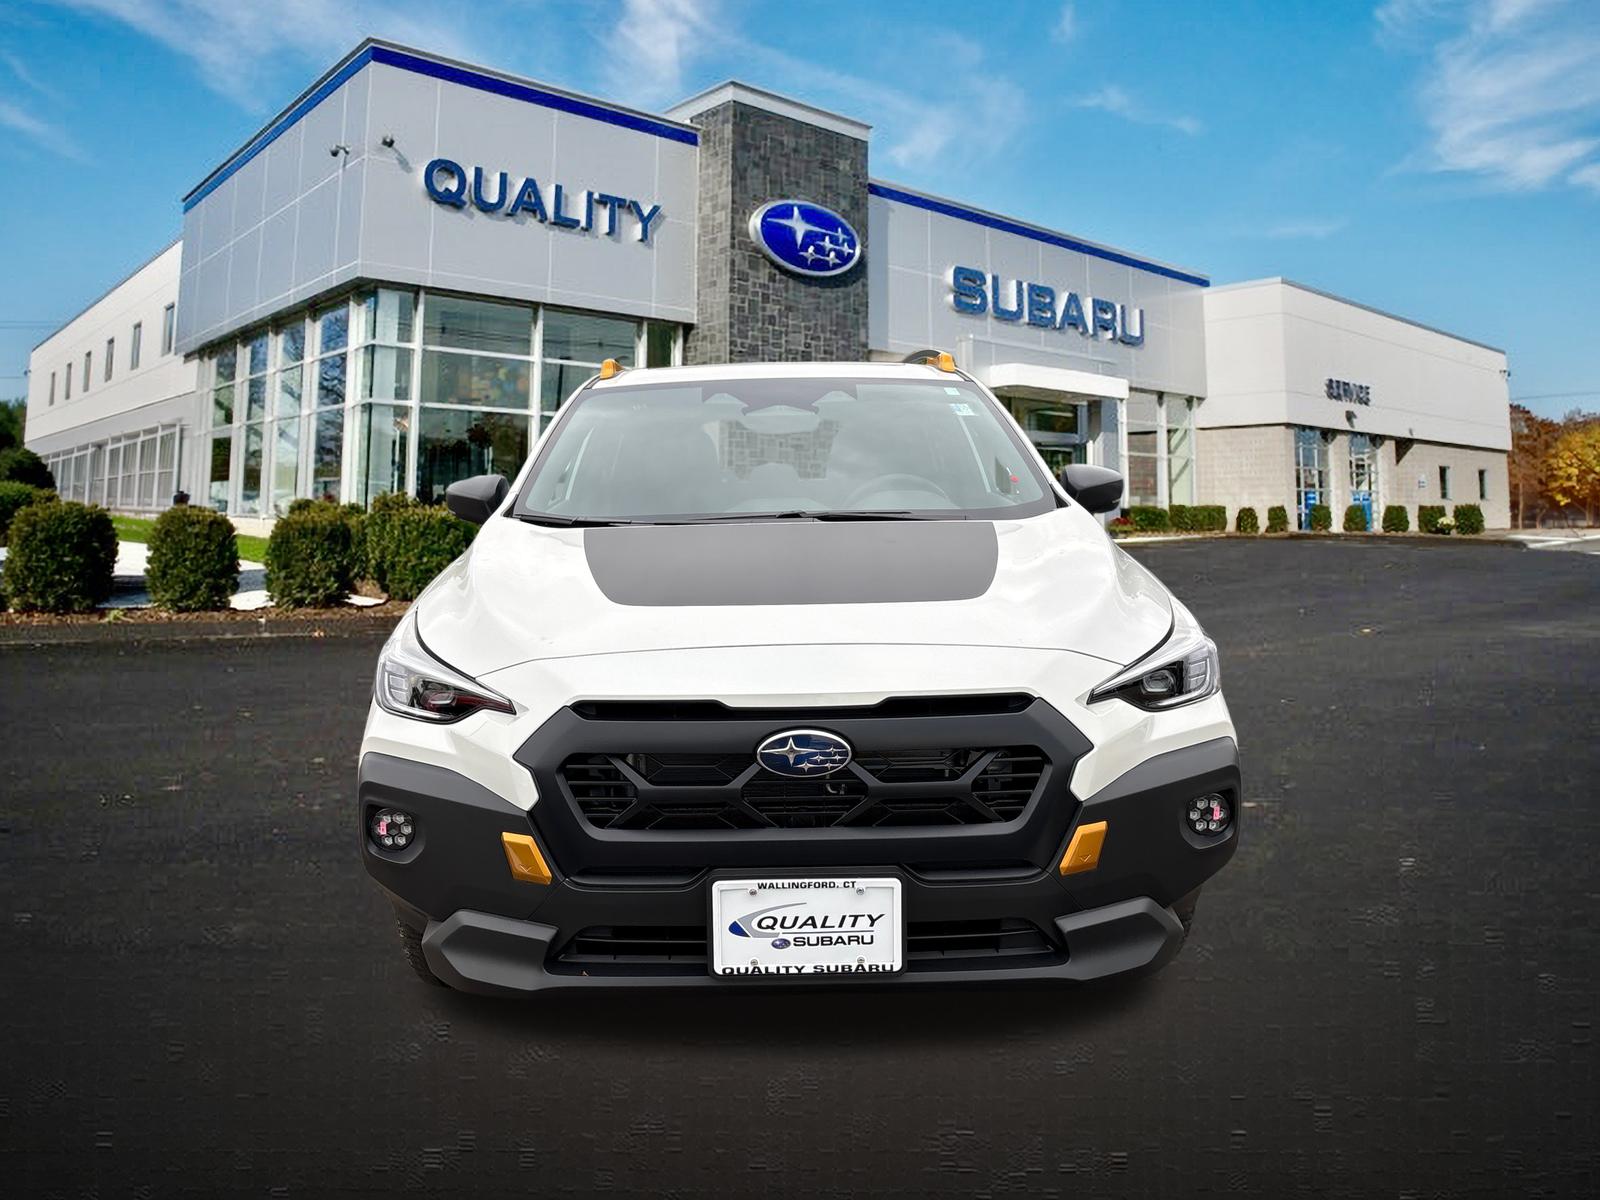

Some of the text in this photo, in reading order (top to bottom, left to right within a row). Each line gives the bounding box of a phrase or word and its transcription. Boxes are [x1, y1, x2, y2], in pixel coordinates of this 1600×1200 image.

[423, 158, 661, 243] QUALITY
[950, 266, 1145, 347] SUBARU
[843, 880, 857, 889] CT
[756, 913, 886, 930] QUALITY
[793, 935, 875, 947] SUBARU
[721, 964, 895, 975] QUALITY SUBARU
